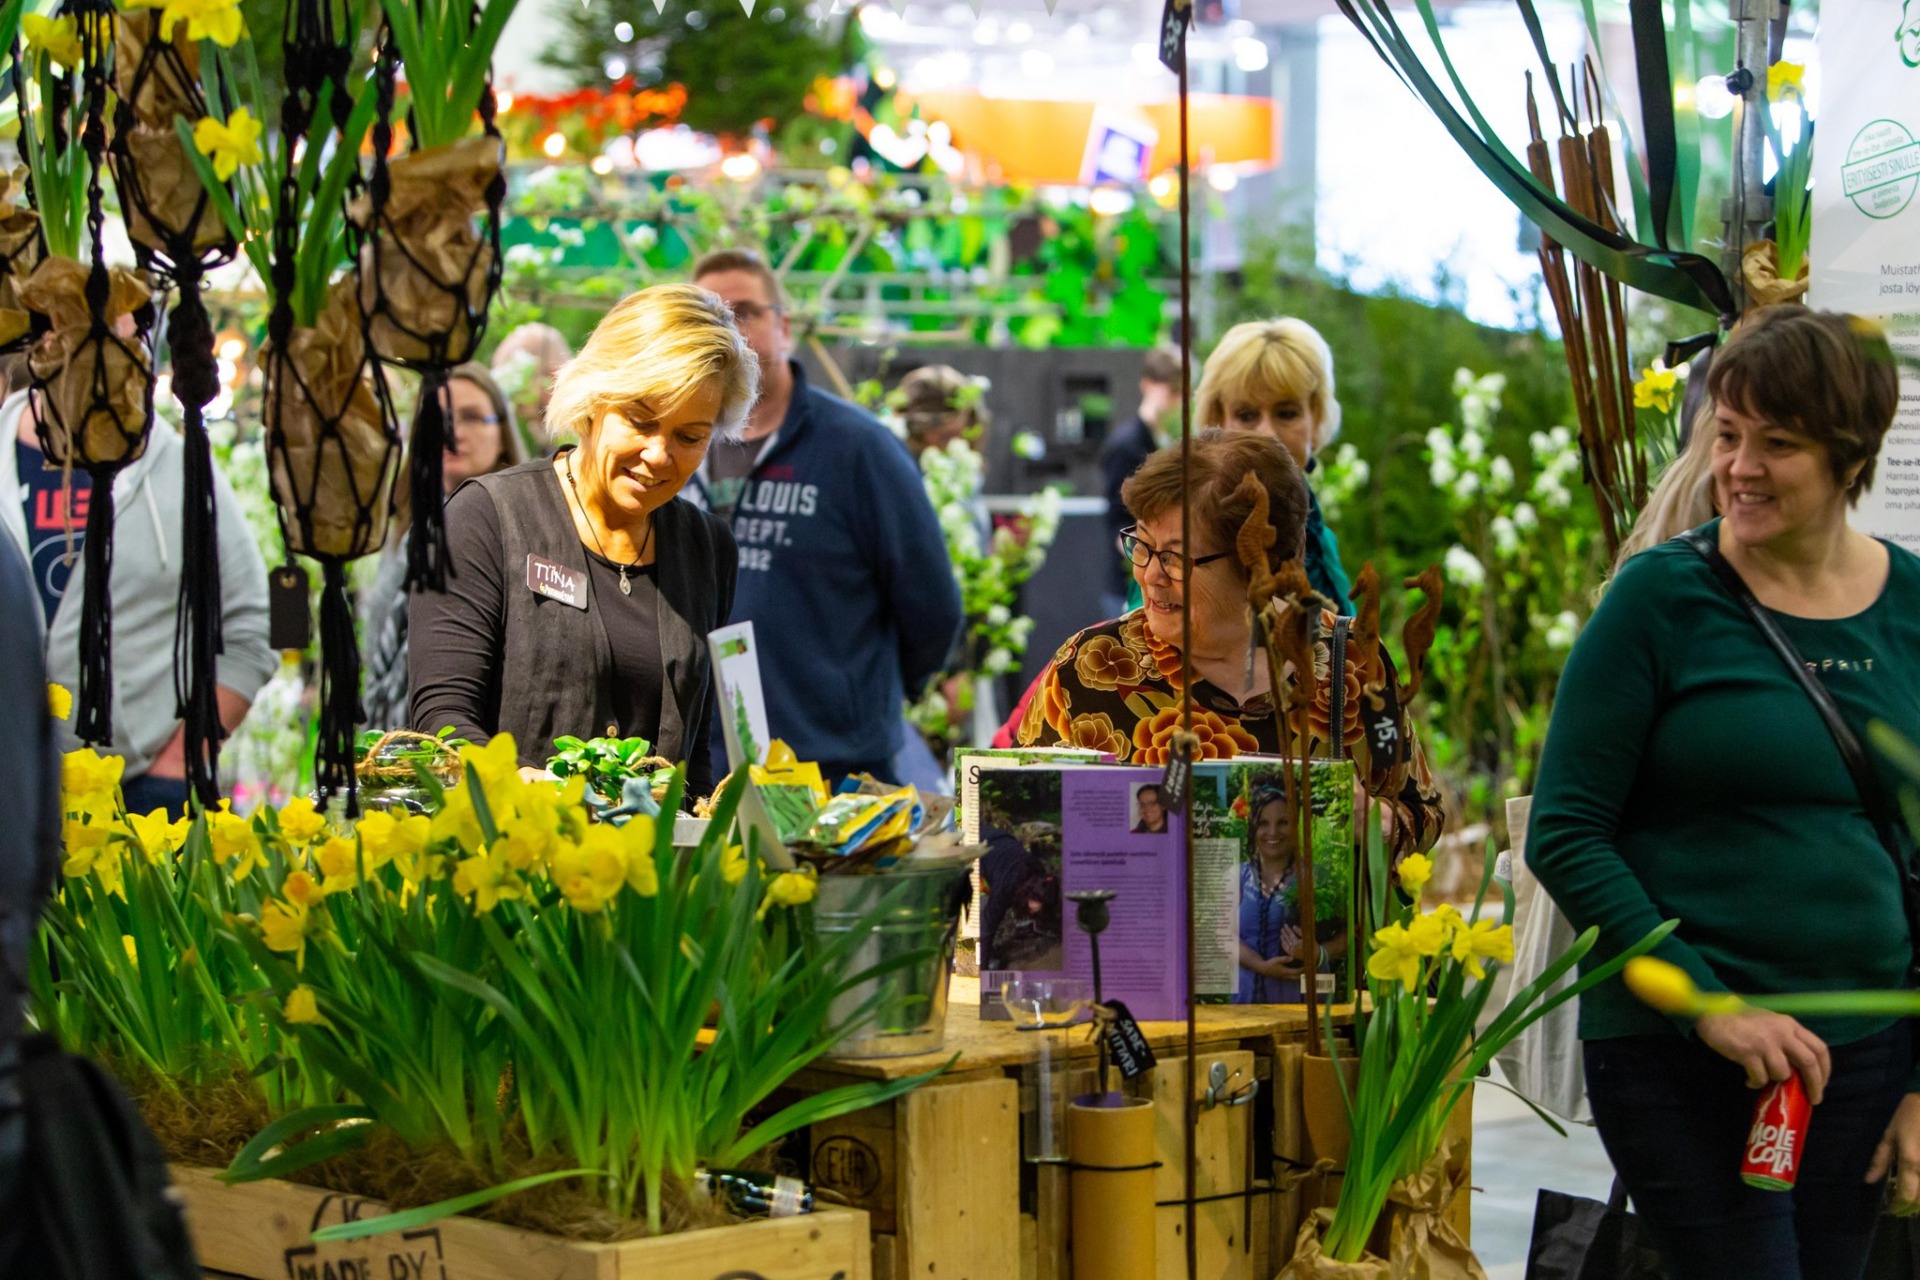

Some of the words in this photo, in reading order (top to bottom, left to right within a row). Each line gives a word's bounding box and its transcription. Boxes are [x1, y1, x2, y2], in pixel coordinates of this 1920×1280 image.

[1879, 282, 1903, 296] josta
[740, 479, 818, 516] LOUIS
[735, 516, 793, 546] DEPT.
[826, 1145, 867, 1188] EUR
[1747, 1141, 1794, 1174] COLA
